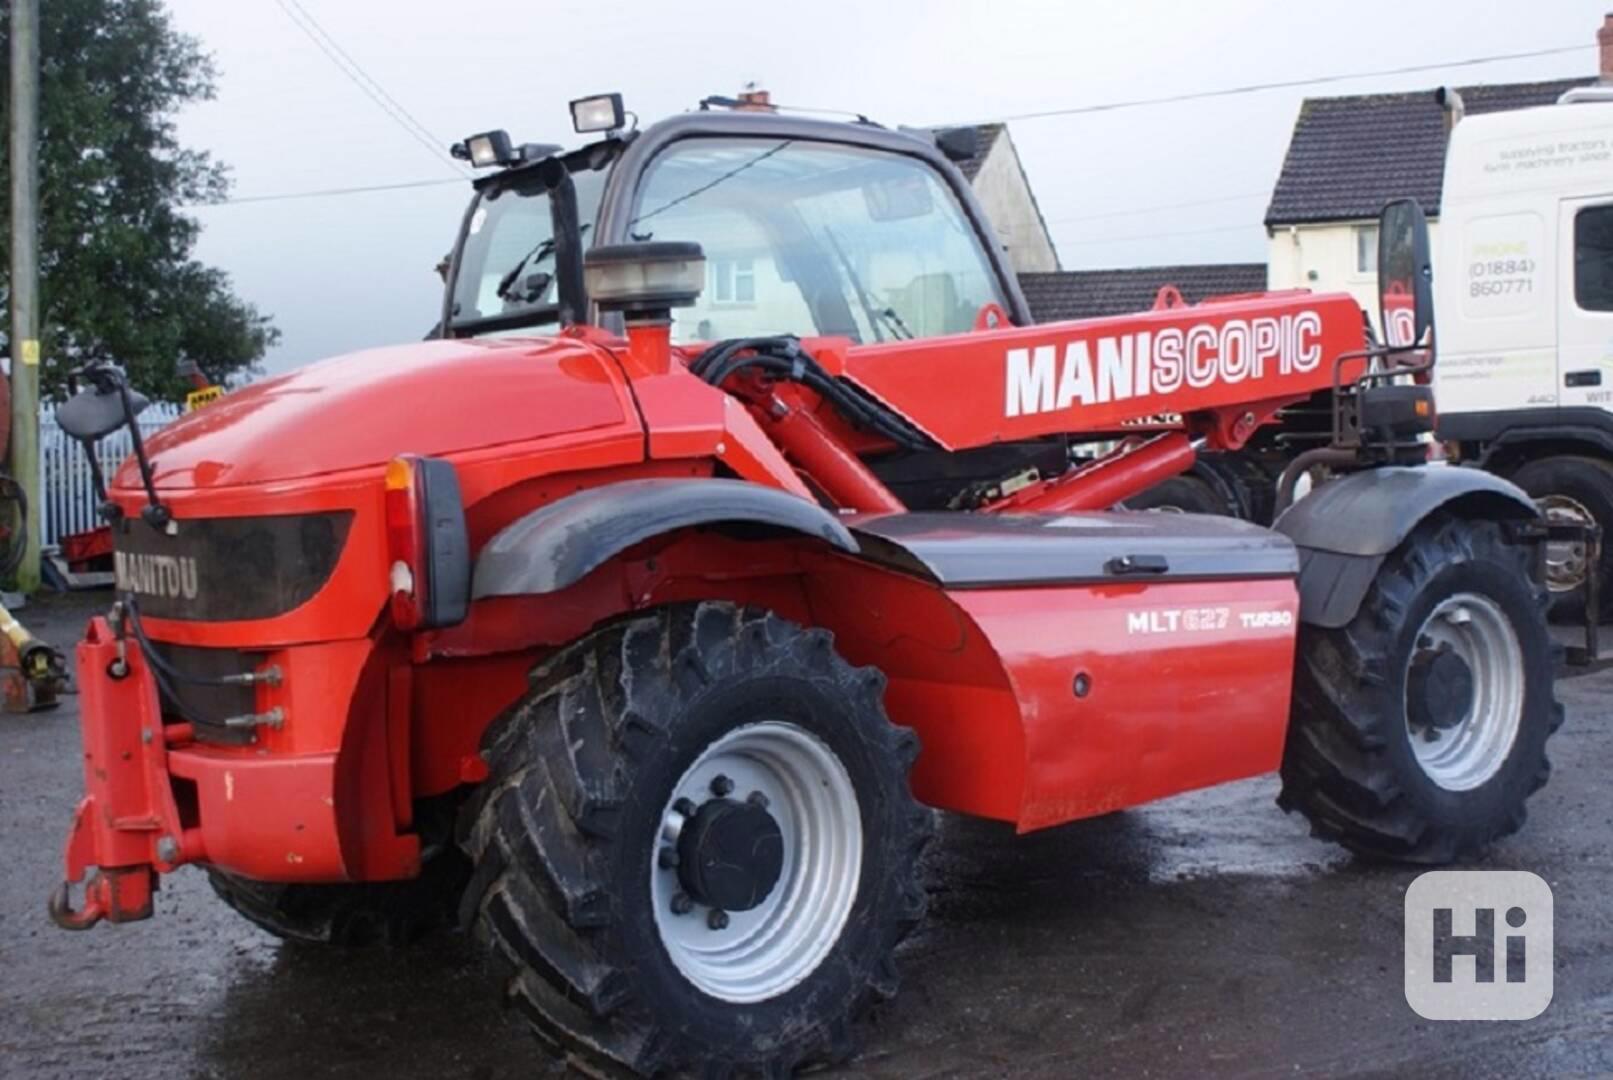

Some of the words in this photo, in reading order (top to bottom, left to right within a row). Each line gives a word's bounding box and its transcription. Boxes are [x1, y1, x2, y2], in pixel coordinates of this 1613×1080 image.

[1468, 259, 1536, 278] (01884)
[1469, 278, 1533, 297] 860771
[1005, 310, 1321, 417] MANISCOPIC
[114, 551, 198, 599] MANITOU
[1239, 611, 1292, 628] TURBO
